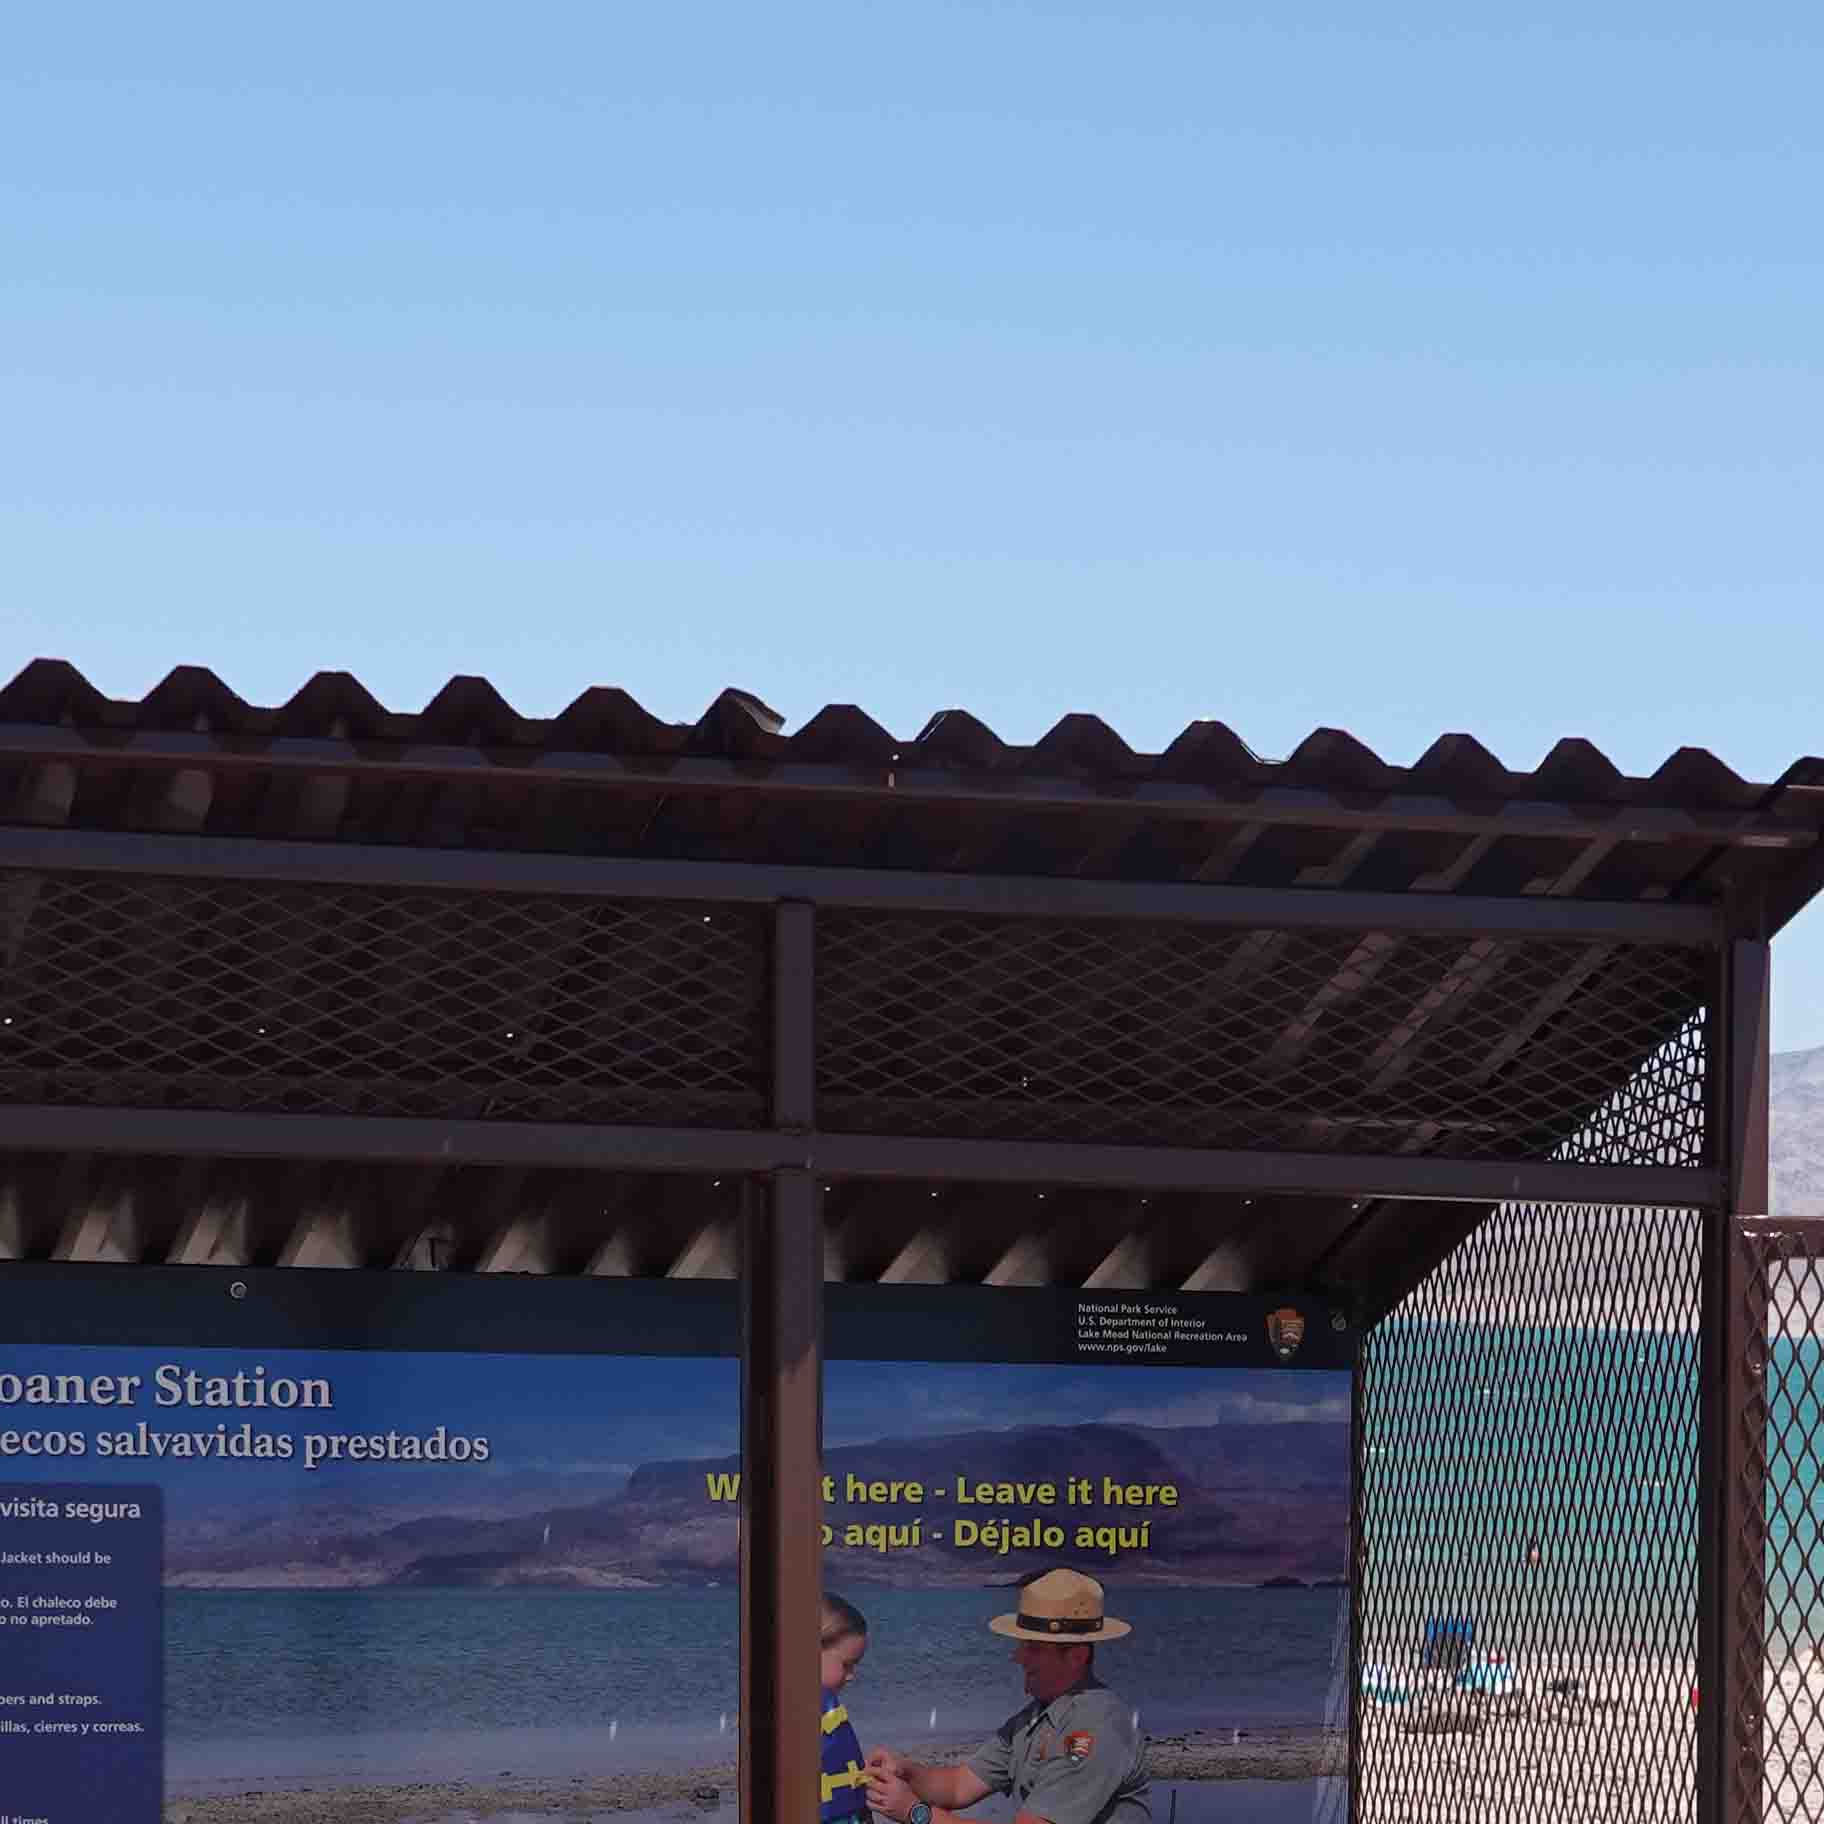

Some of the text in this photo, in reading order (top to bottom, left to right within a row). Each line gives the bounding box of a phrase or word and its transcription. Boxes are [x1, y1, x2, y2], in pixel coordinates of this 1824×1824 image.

[1079, 1304, 1177, 1314] National Park Service
[1078, 1316, 1096, 1325] U.S.
[1100, 1317, 1155, 1328] Department
[1158, 1318, 1168, 1327] of
[1078, 1329, 1099, 1338] Lake
[1132, 1330, 1171, 1339] National
[1174, 1331, 1223, 1340] Recreation
[1226, 1333, 1247, 1342] Area
[1078, 1343, 1167, 1354] www.nps.gov/lake
[156, 1365, 332, 1407] Station
[97, 1422, 292, 1457] salvavidas
[304, 1426, 488, 1468] prestados
[705, 1471, 741, 1502] W
[847, 1473, 923, 1502] here
[958, 1477, 1055, 1504] Leave
[1069, 1477, 1092, 1504] it
[1104, 1477, 1177, 1505] here
[0, 1497, 58, 1517] visita
[66, 1503, 140, 1523] segura
[844, 1518, 920, 1552] aquí
[955, 1519, 1064, 1554] Déjalo
[1076, 1521, 1150, 1554] aquí
[1, 1552, 42, 1563] Jacket
[46, 1552, 90, 1563] should
[95, 1552, 111, 1564] be
[17, 1596, 28, 1608] El
[32, 1596, 81, 1608] chaleco
[85, 1596, 117, 1608] debe
[11, 1616, 27, 1624] no
[31, 1613, 93, 1627] apretado.
[30, 1693, 54, 1704] and
[59, 1695, 101, 1707] straps.
[34, 1720, 77, 1732] cierres
[81, 1724, 89, 1735] y
[93, 1723, 144, 1732] correas.
